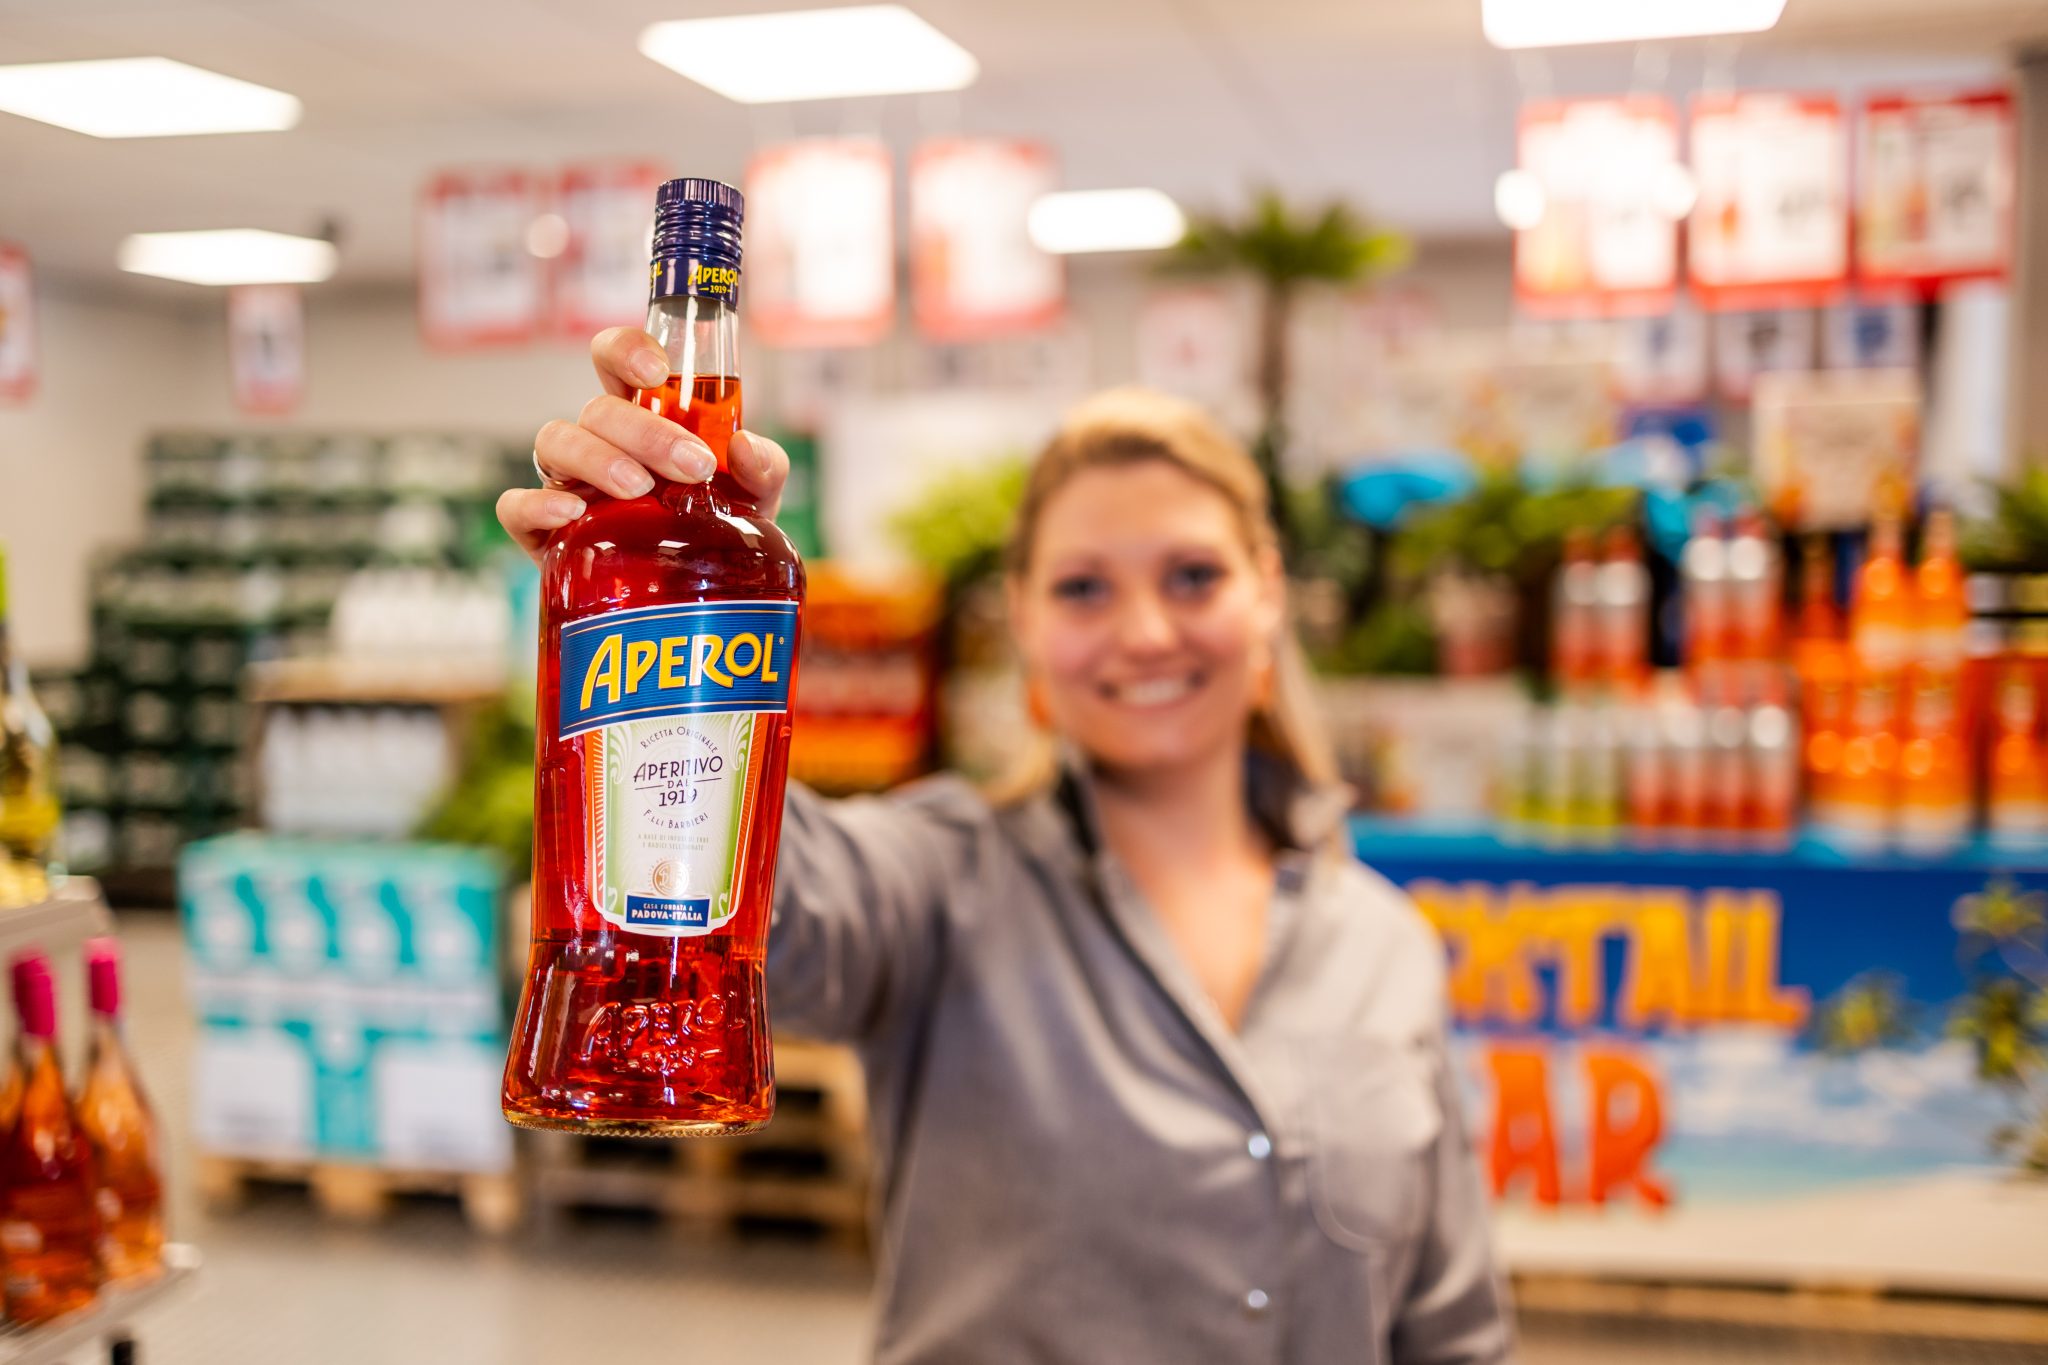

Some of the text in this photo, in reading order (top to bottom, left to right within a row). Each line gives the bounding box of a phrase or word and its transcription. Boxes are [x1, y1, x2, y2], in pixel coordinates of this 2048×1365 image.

[710, 285, 727, 293] 1919
[580, 632, 778, 711] APEROL
[640, 726, 718, 753] RICETTA ORIGINALE
[633, 755, 723, 783] APERITIVO
[668, 812, 709, 829] BARBIERI
[1483, 1035, 1677, 1212] AR
